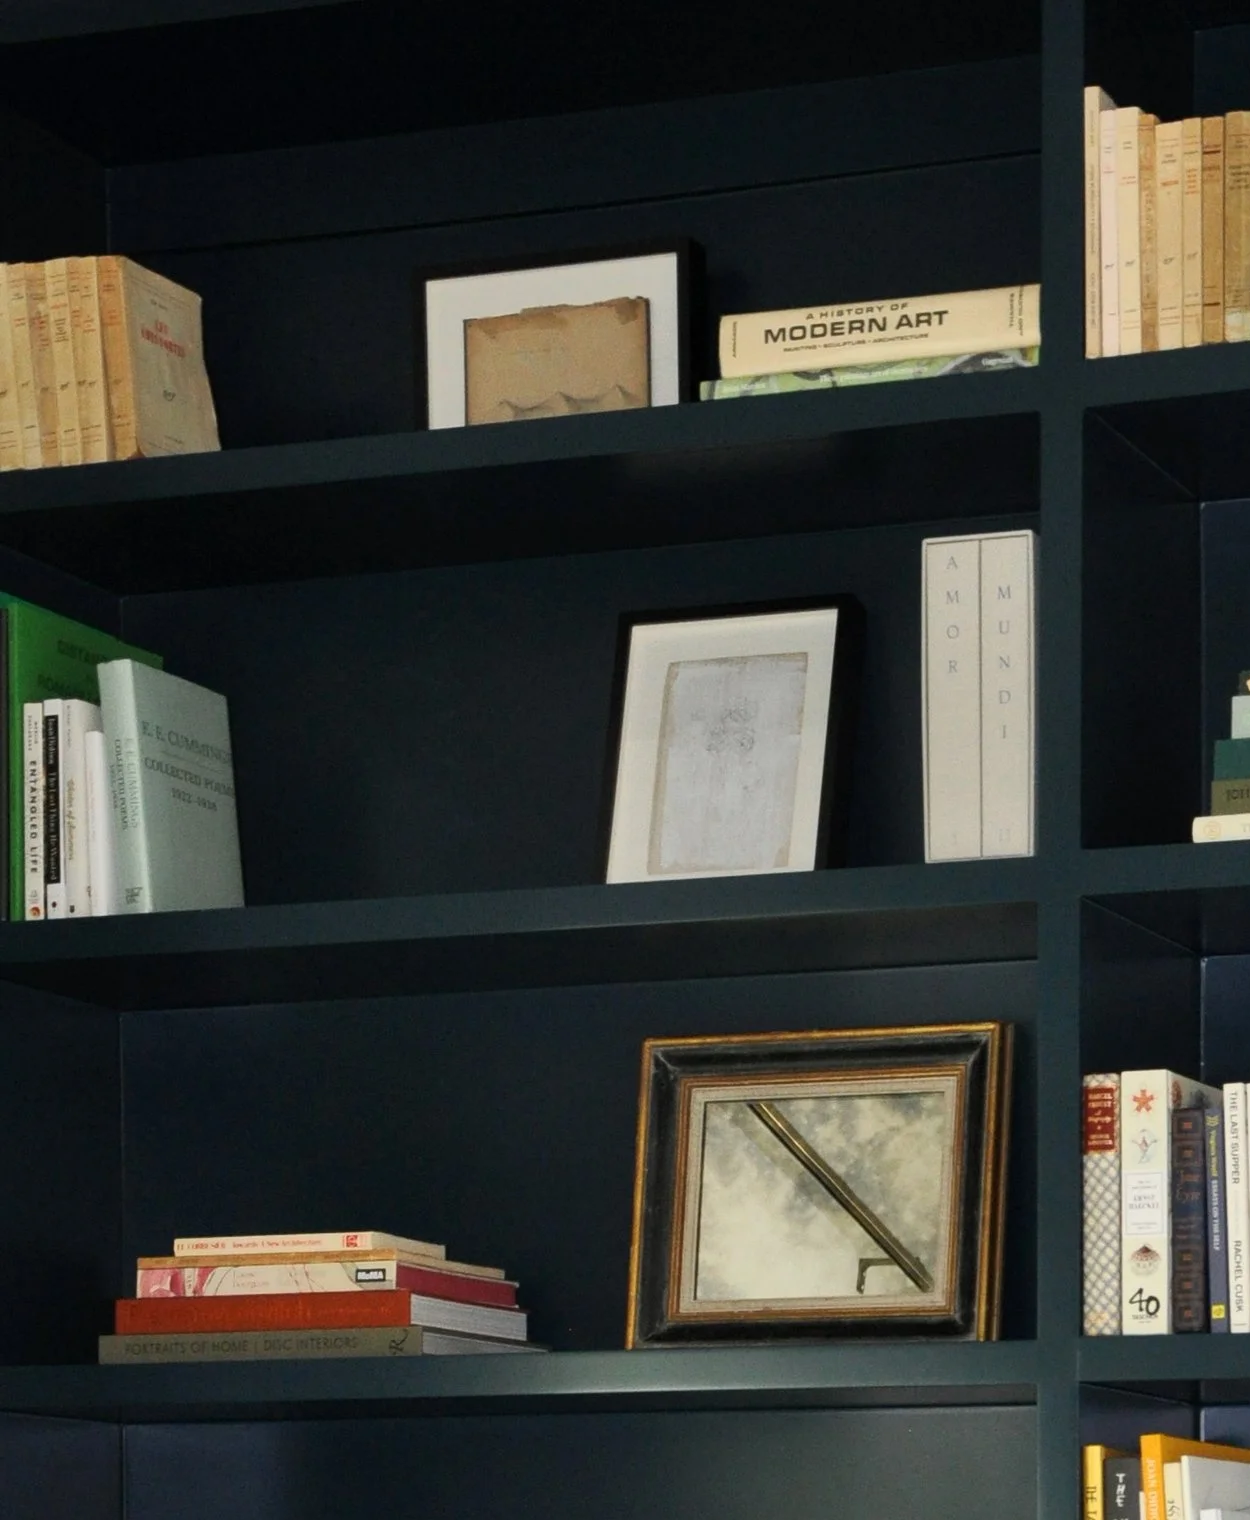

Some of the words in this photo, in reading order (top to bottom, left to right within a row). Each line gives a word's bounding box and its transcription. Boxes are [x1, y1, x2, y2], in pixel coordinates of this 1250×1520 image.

[806, 313, 814, 321] A
[819, 304, 885, 320] HISTORY
[890, 302, 910, 312] OF
[763, 316, 888, 345] MODERN
[895, 310, 950, 330] ART
[945, 556, 961, 674] AMOR
[996, 587, 1012, 740] MUNDI
[29, 760, 38, 840] ENTANGLED
[30, 846, 39, 874] LIFE
[1230, 1091, 1238, 1112] THE
[1230, 1114, 1239, 1140] LAST
[1231, 1142, 1240, 1184] SUPPER
[1211, 1179, 1219, 1205] ESSAYS
[1233, 1240, 1242, 1281] RACHEL
[1129, 1288, 1160, 1316] 40
[1234, 1283, 1243, 1313] CUSK
[124, 1342, 187, 1356] PORTRAITS
[190, 1342, 210, 1354] OF
[212, 1340, 249, 1353] HOME
[263, 1338, 293, 1351] DISC
[298, 1336, 358, 1350] INTERIORS
[1147, 1459, 1158, 1492] JOAN
[1086, 1486, 1098, 1503] THE
[1115, 1474, 1127, 1508] THE
